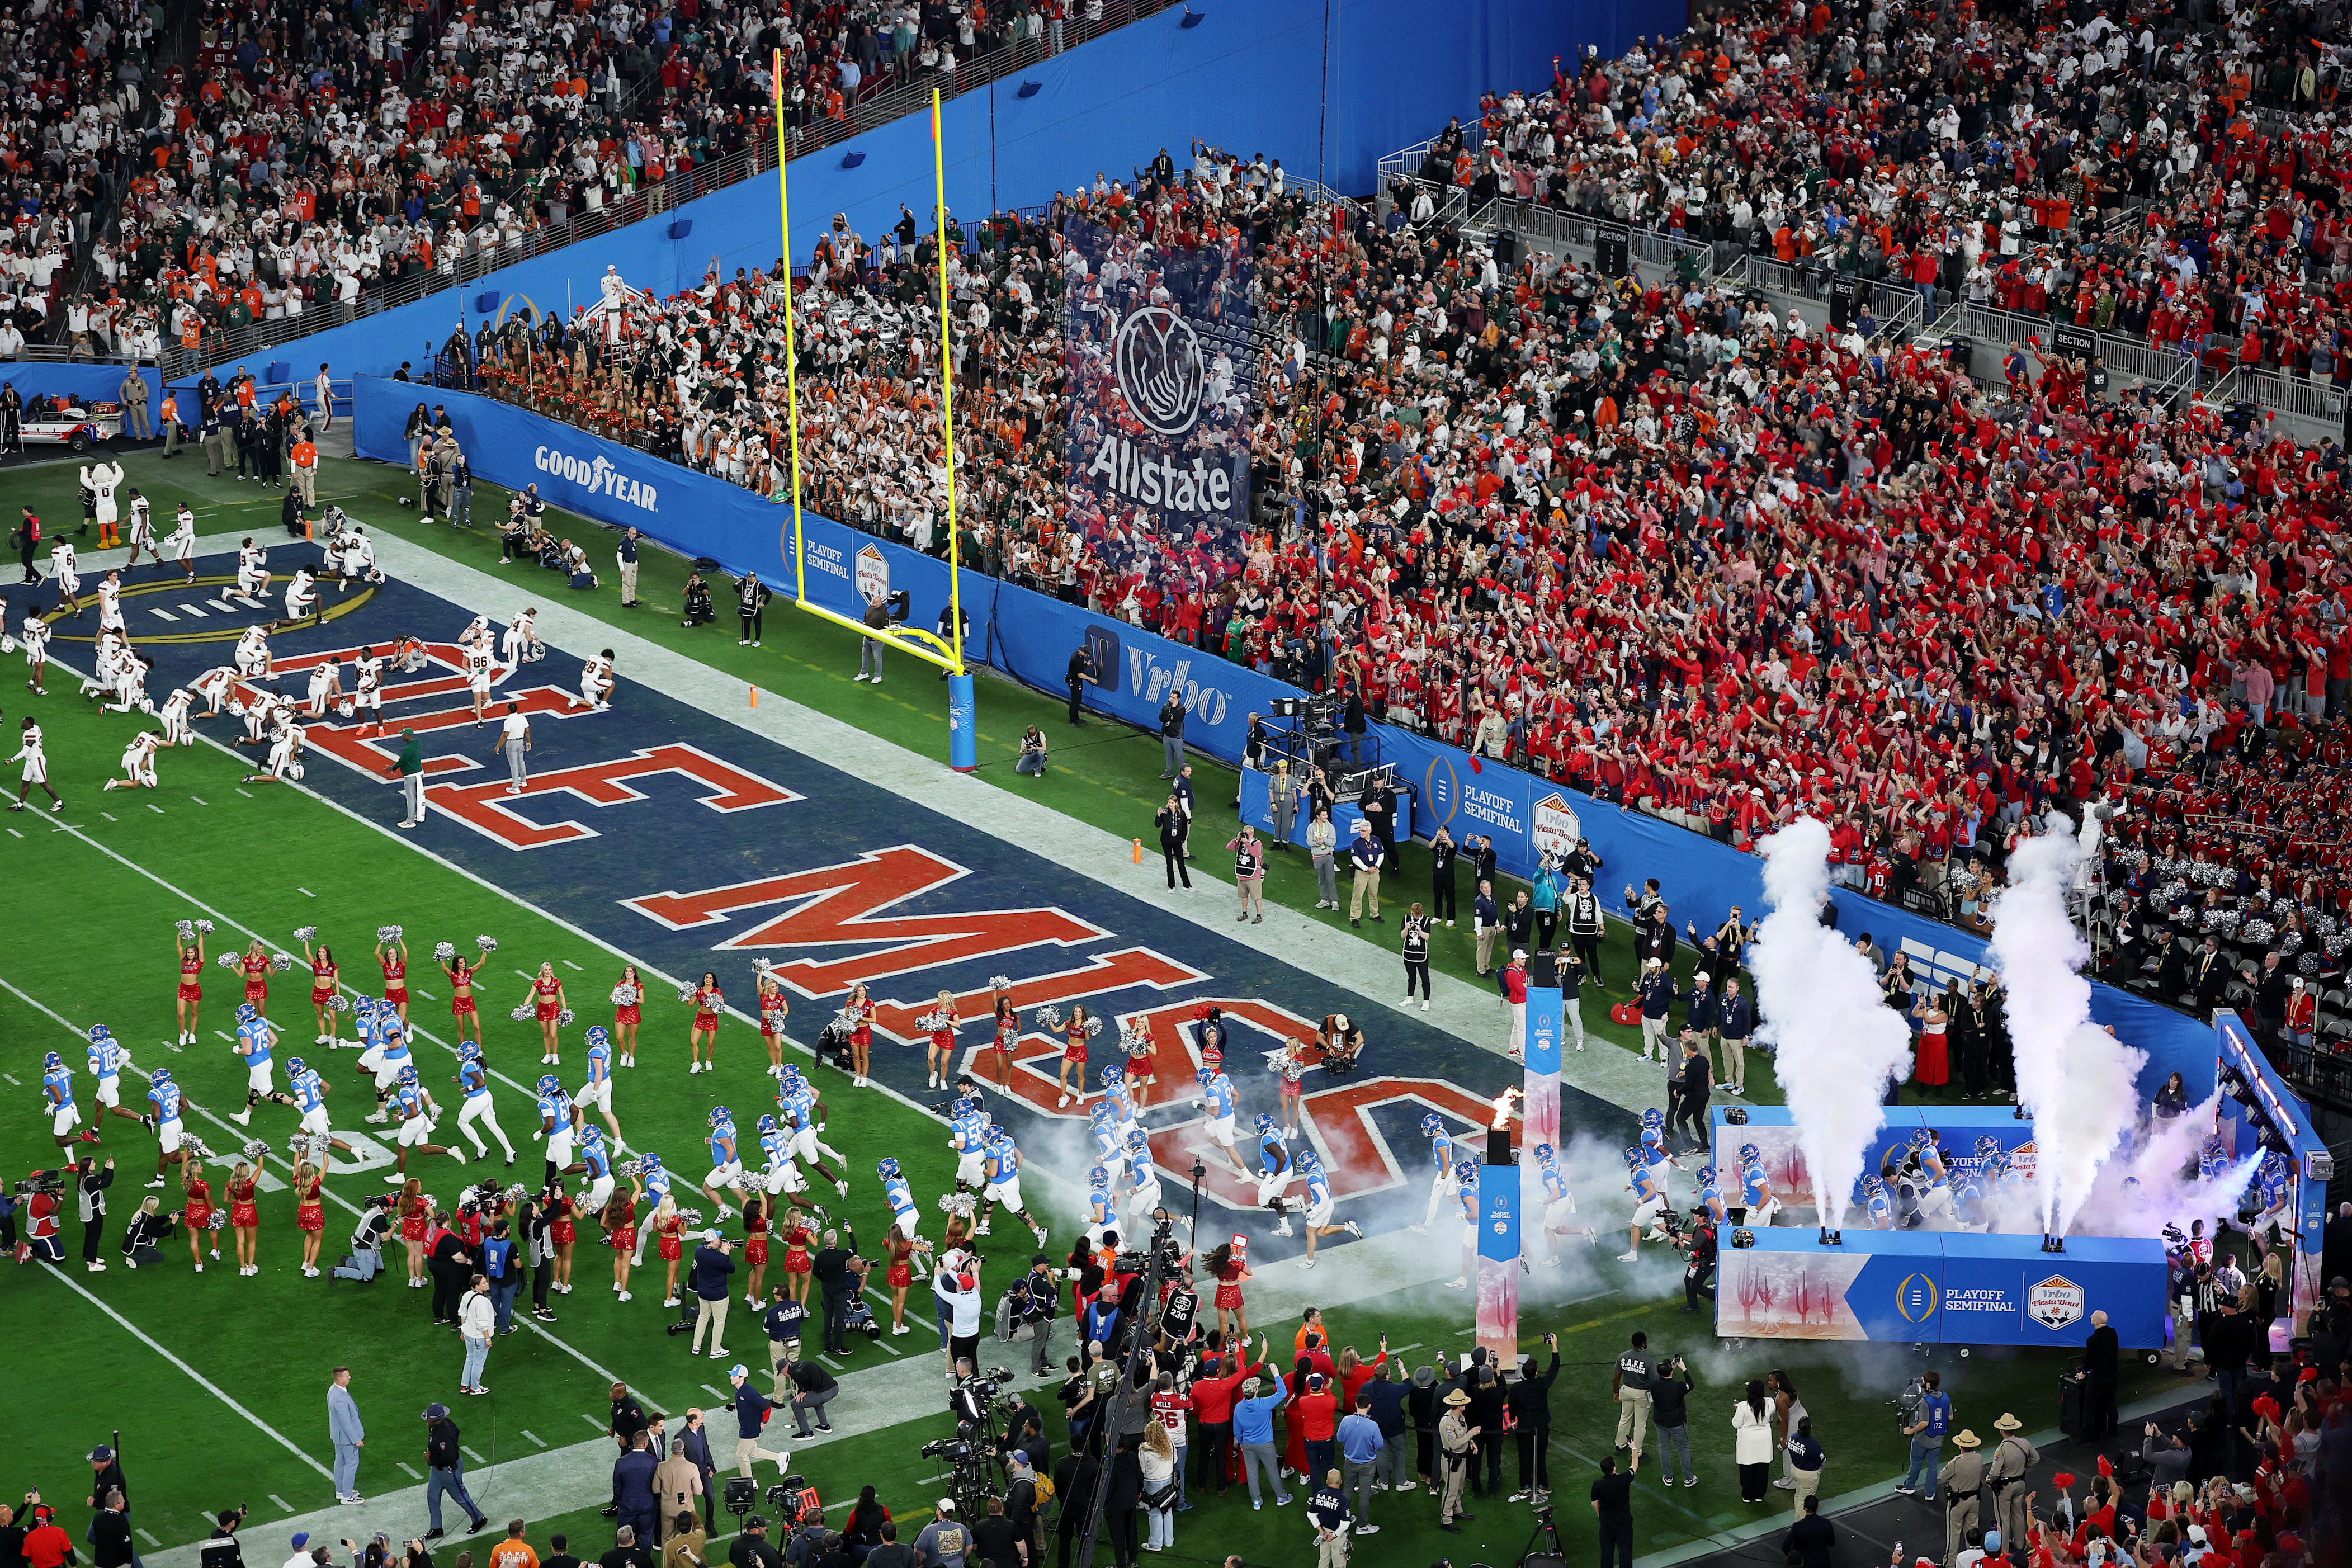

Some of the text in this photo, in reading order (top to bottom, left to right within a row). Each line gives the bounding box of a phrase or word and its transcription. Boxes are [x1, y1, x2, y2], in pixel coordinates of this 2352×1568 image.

[1599, 229, 1626, 242] SECTION
[1836, 283, 1854, 294] SECT
[2058, 334, 2090, 348] SECTION
[535, 446, 656, 512] GOODYEAR
[1087, 433, 1231, 511] Allstate
[67, 553, 72, 566] 6
[807, 540, 842, 563] PLAYOFF
[807, 555, 849, 579] SEMIFINAL
[858, 569, 887, 587] Fiesta Bowl
[2047, 594, 2054, 606] 6
[473, 656, 487, 668] 86
[1127, 645, 1227, 725] Vrbo
[1465, 785, 1513, 813] PLAYOFF
[1464, 801, 1522, 834] SEMIFINAL
[1545, 811, 1569, 829] Vrbo
[1536, 824, 1576, 846] Fiesta Bowl
[253, 1031, 269, 1052] 75
[103, 1050, 116, 1071] 16
[310, 1084, 319, 1102] 6
[1225, 1088, 1231, 1106] 9
[164, 1096, 180, 1118] 38
[802, 1105, 809, 1122] 3
[1003, 1152, 1016, 1173] 69
[1945, 1289, 2005, 1300] PLAYOFF
[2042, 1290, 2071, 1298] Vrbo
[778, 1306, 801, 1317] S.A.F.E.
[1945, 1301, 2016, 1312] SEMIFINAL
[2057, 1299, 2080, 1309] Bowl
[779, 1310, 802, 1322] SECURITY
[1170, 1309, 1187, 1321] 230
[1621, 1358, 1646, 1371] S.A.F.E.
[1155, 1411, 1178, 1429] 26
[1315, 1498, 1339, 1510] SECURITY
[1316, 1493, 1339, 1505] S.A.F.E.
[499, 1555, 528, 1564] SECURITY
